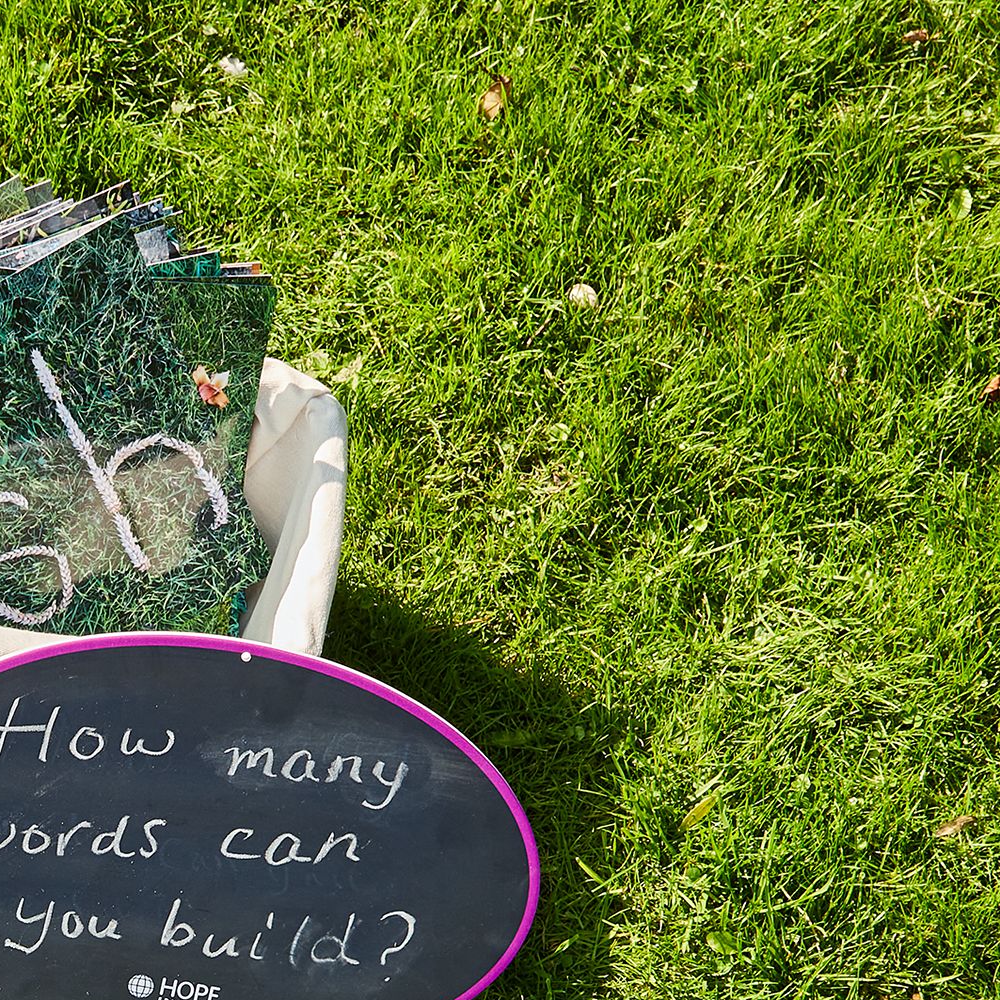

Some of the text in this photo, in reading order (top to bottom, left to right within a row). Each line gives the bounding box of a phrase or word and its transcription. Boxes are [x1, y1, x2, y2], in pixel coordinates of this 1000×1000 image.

[224, 742, 408, 810] many
[220, 828, 360, 865] can
[4, 898, 417, 982] you build?
